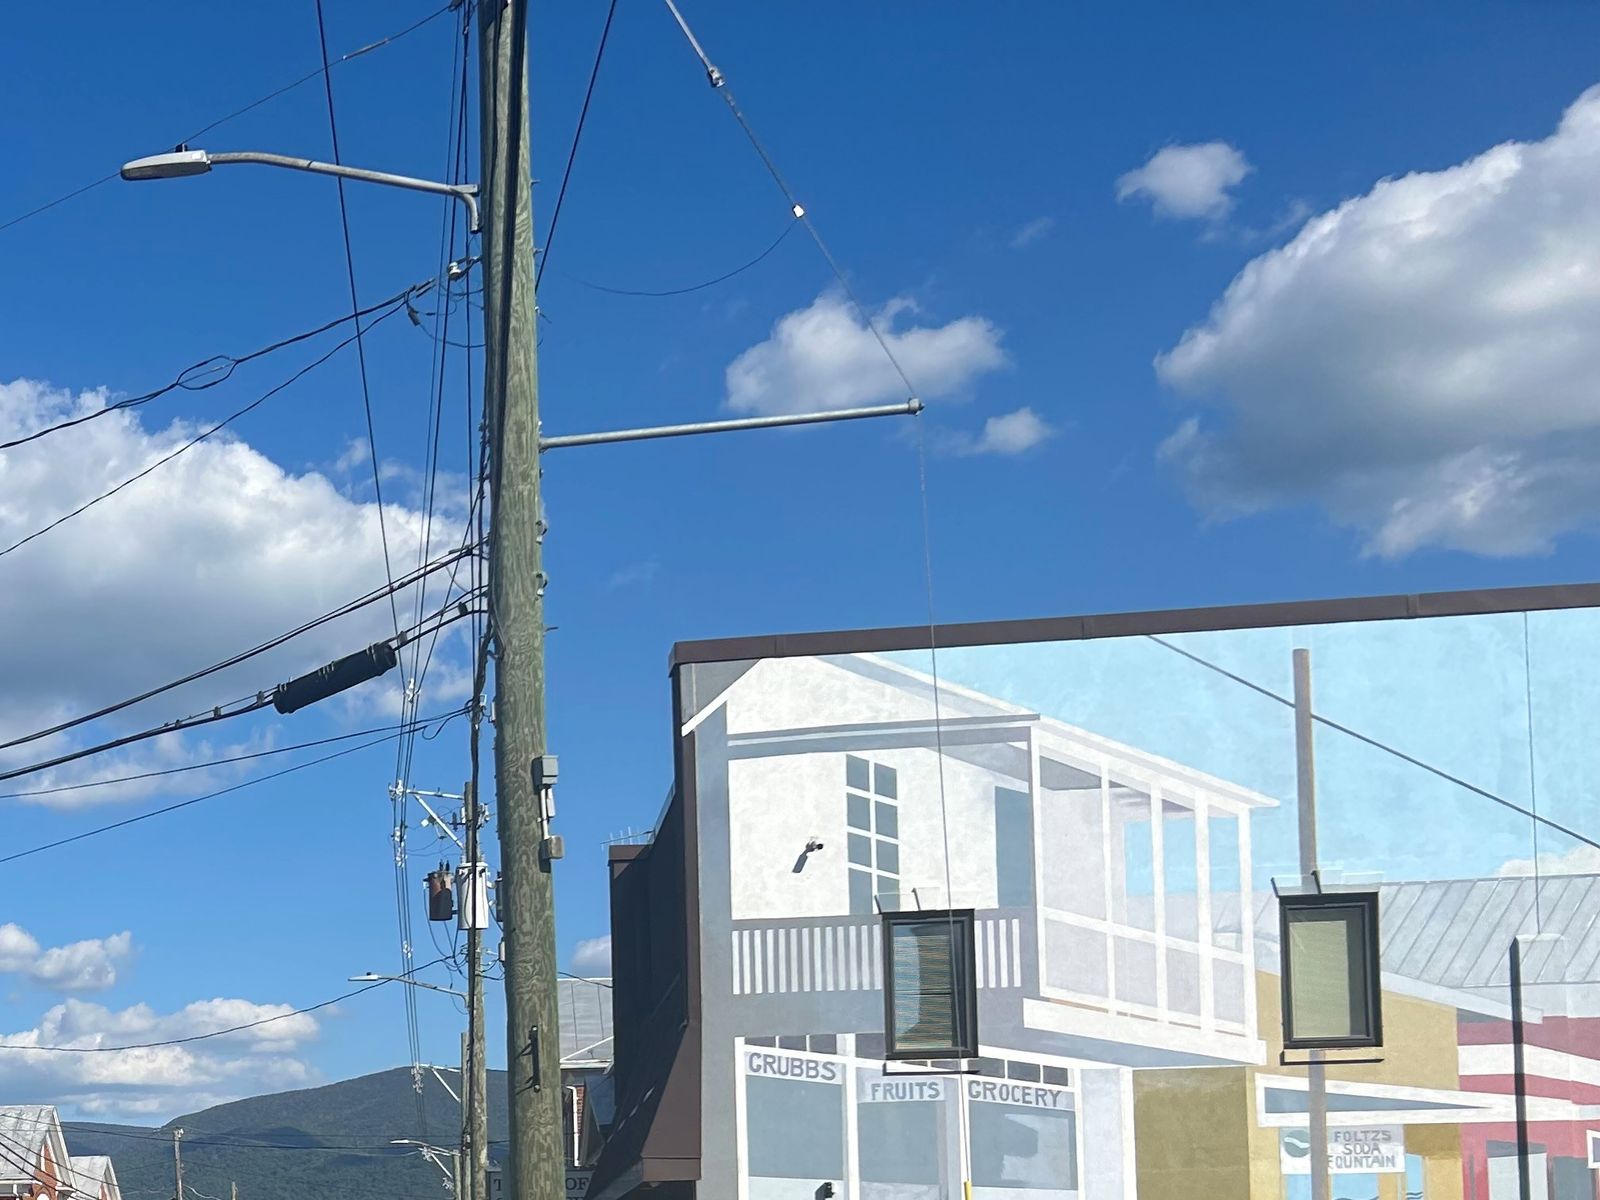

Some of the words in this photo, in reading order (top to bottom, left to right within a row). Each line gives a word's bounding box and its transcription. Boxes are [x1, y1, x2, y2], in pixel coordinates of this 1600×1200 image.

[750, 1052, 836, 1081] GRUBBS
[870, 1081, 941, 1101] FRUITS
[968, 1080, 1062, 1108] GROCERY
[1342, 1142, 1382, 1155] SODA
